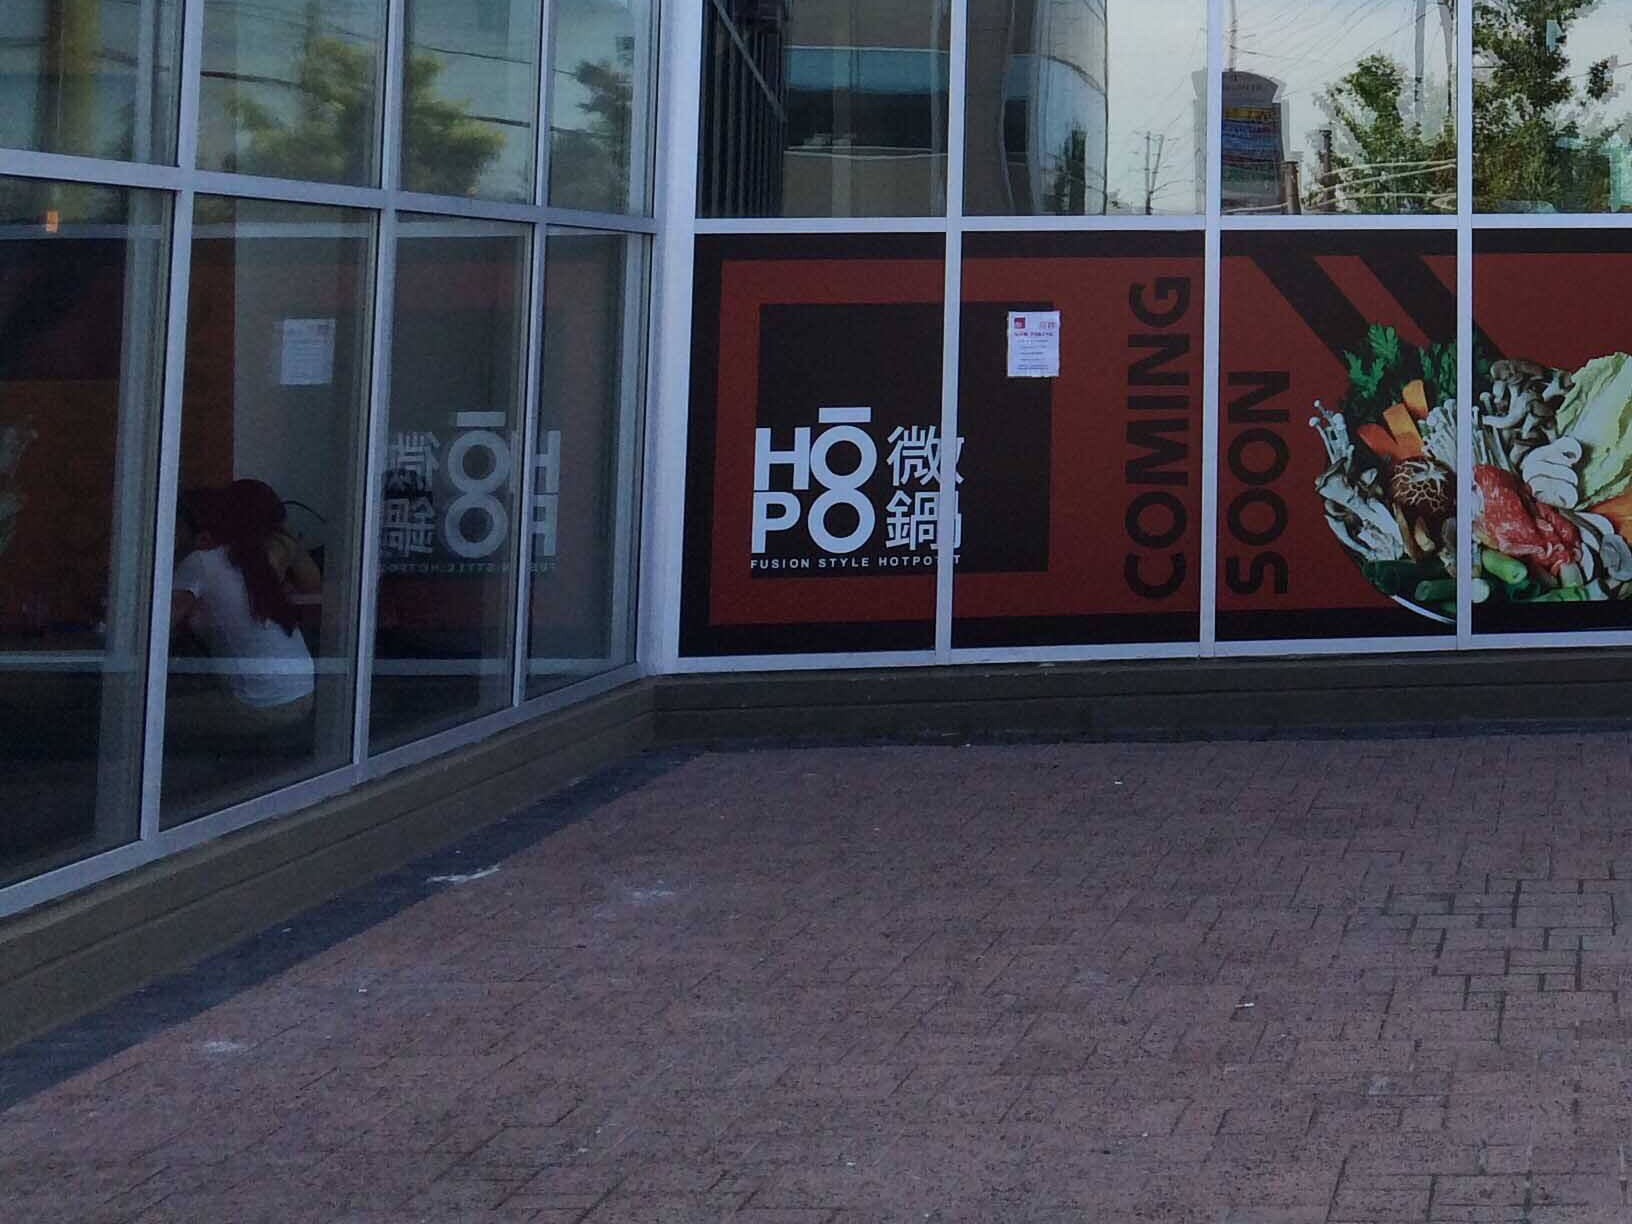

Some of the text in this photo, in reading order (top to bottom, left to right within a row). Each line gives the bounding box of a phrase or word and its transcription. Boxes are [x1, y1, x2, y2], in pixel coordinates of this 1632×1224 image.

[1123, 276, 1191, 600] COMING
[1225, 370, 1290, 595] SOON
[750, 558, 811, 569] FUSION
[818, 557, 870, 568] STYLE
